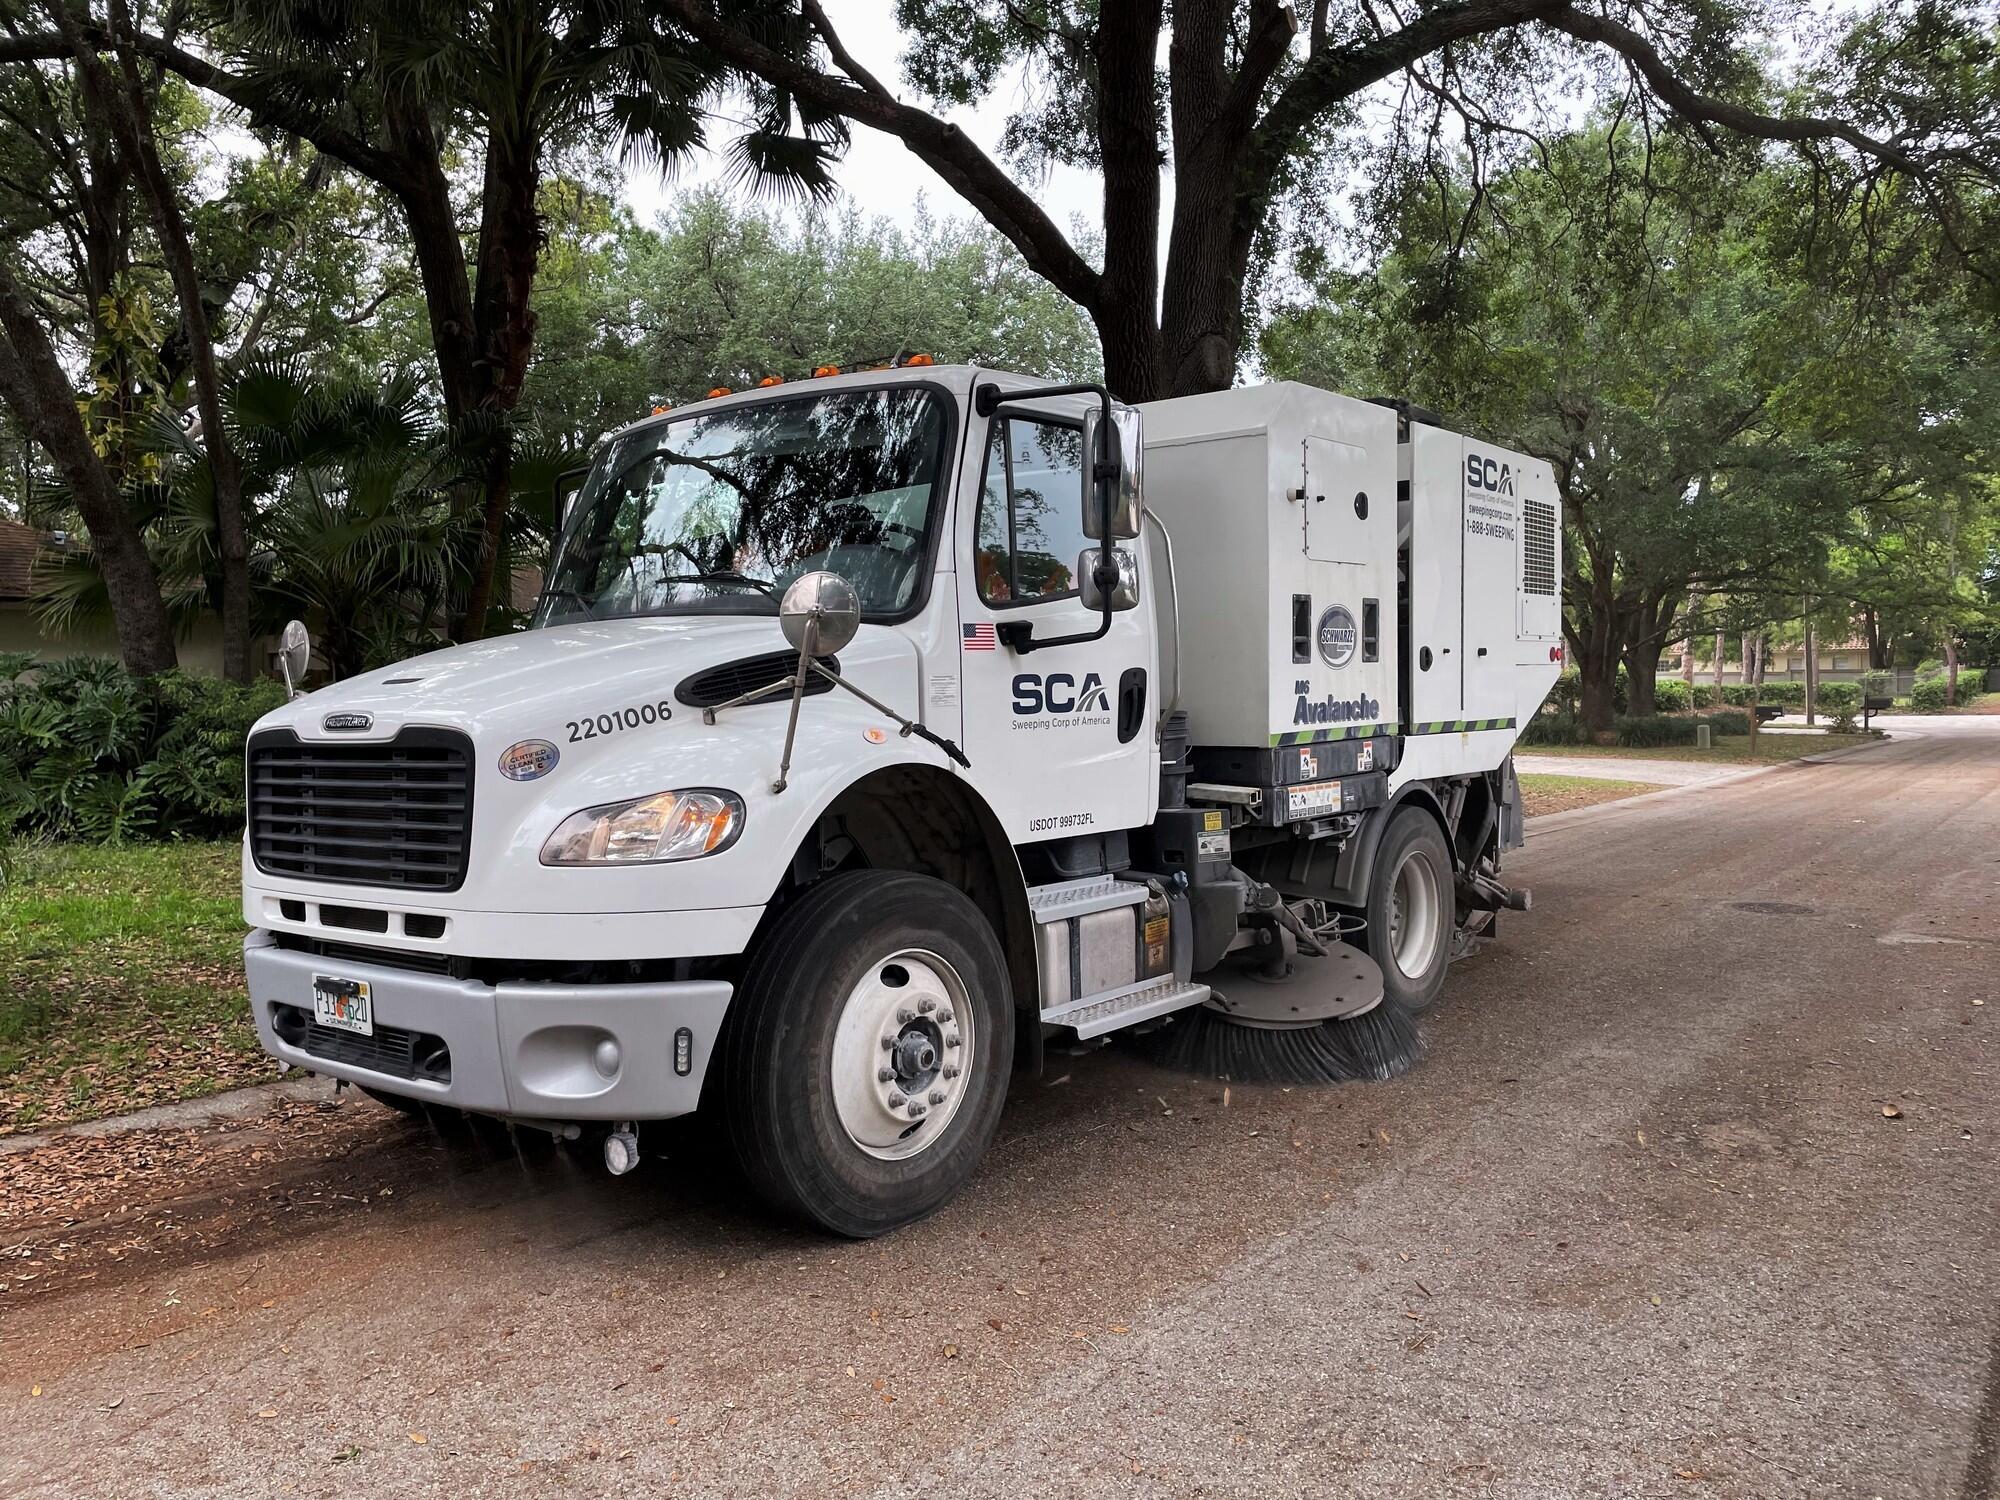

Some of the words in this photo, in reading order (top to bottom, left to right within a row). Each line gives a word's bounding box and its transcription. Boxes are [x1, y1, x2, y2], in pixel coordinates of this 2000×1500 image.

[1467, 454, 1514, 496] SCA
[1468, 504, 1513, 521] sweepingcorp.com
[1466, 519, 1515, 541] 1-888-SWEEPING
[1321, 629, 1354, 643] SCHWARZE
[1012, 673, 1110, 715] SCA
[1293, 693, 1380, 725] Avalanche
[566, 700, 672, 743] 2201006
[1012, 719, 1050, 731] Sweeping
[1052, 718, 1070, 729] Corp
[1072, 717, 1080, 726] of
[1082, 716, 1111, 725] America
[508, 759, 533, 770] CLEAN
[535, 754, 552, 762] IDLE
[510, 749, 546, 763] CERTIFIED
[1030, 817, 1058, 832] USDOT
[1059, 813, 1095, 828] 999732FL
